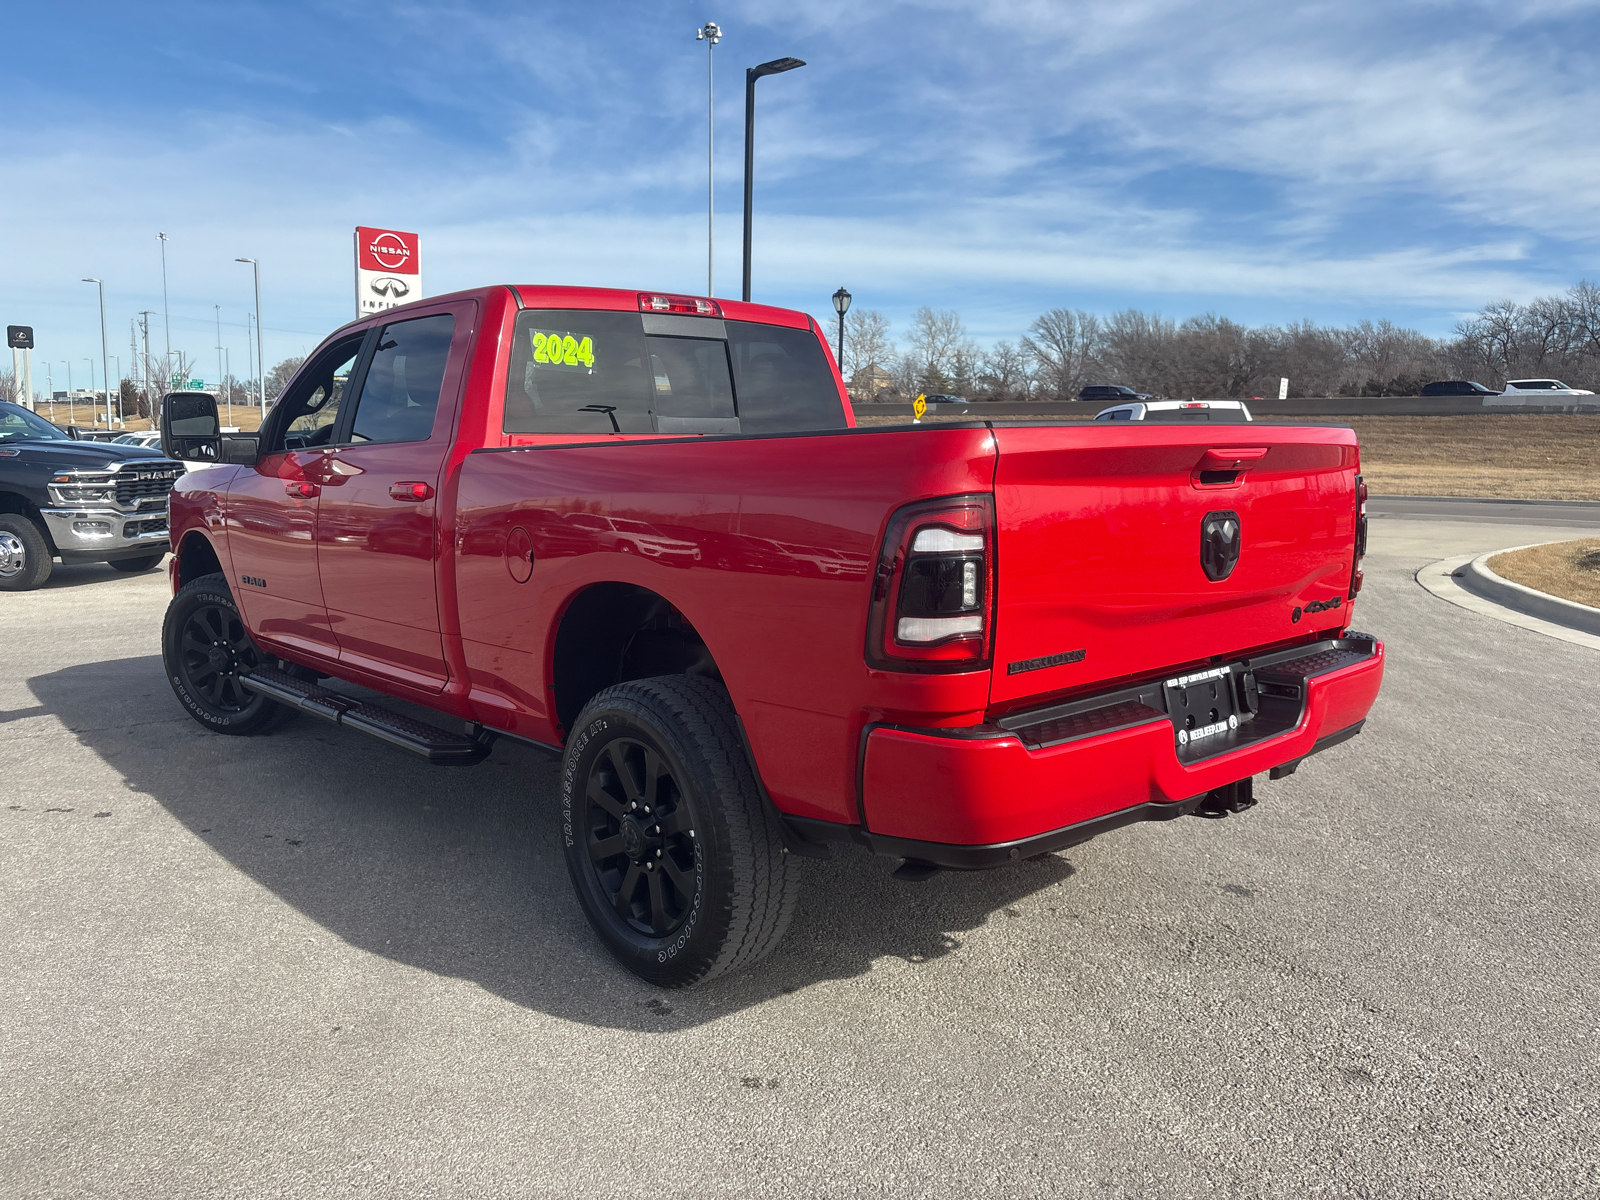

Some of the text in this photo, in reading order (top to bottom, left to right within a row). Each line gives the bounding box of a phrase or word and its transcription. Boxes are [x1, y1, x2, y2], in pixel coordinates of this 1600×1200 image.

[369, 244, 411, 257] NISSAN
[362, 300, 399, 309] INFIN
[532, 332, 595, 368] 2024
[139, 469, 176, 480] RAM
[241, 575, 266, 588] RAM
[1188, 672, 1208, 682] CHRYSLER
[563, 732, 589, 847] TRANSFORCE
